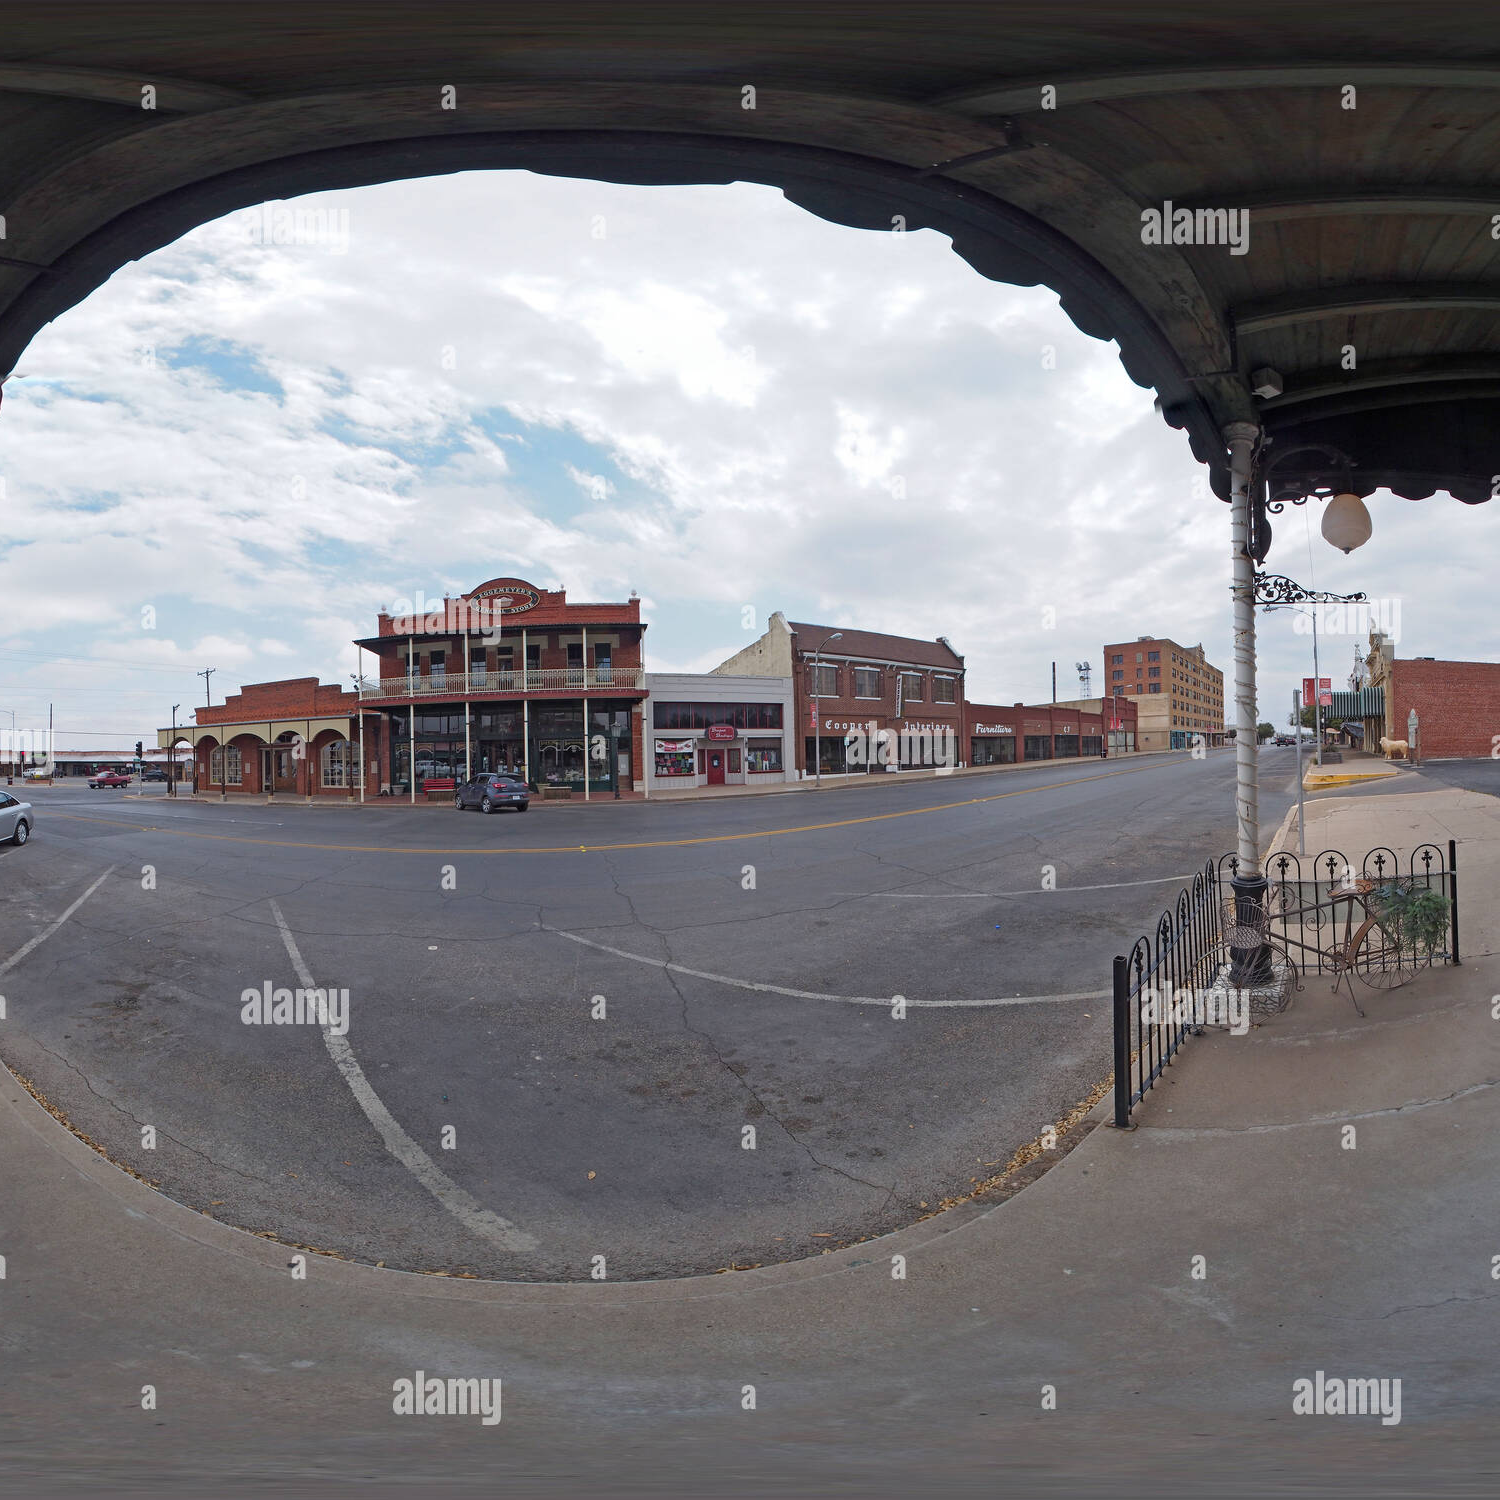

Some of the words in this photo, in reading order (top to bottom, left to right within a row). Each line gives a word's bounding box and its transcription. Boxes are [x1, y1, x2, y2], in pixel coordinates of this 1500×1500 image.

[510, 603, 534, 612] STORE
[825, 720, 870, 732] Cooper
[975, 723, 1012, 734] Furniture
